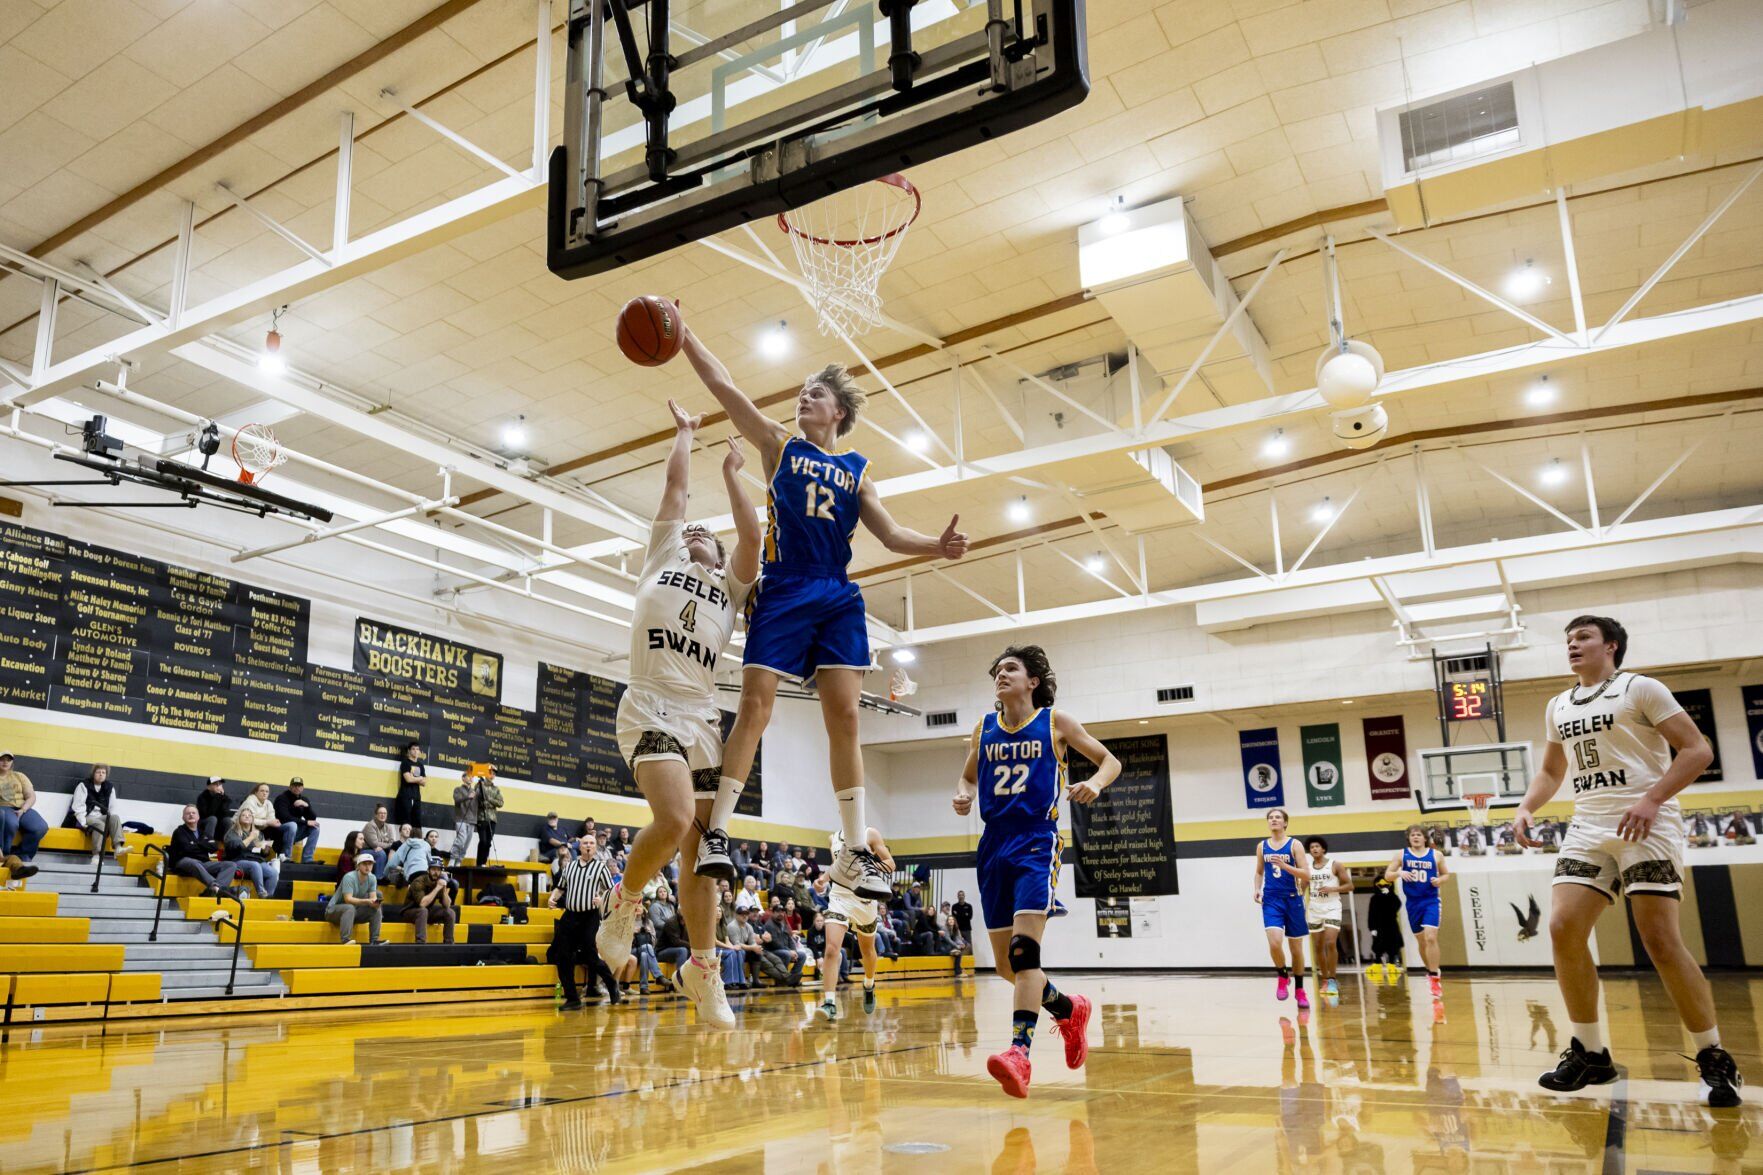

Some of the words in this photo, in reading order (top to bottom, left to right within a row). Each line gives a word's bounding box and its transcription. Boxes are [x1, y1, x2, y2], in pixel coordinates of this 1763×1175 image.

[791, 455, 855, 495] VICTOR
[806, 481, 836, 521] 12
[5, 528, 42, 543] Alliance
[6, 551, 32, 565] Cahoon
[34, 558, 50, 569] Golf
[68, 545, 81, 556] The
[83, 549, 103, 563] Doug
[8, 561, 17, 574] by
[27, 586, 59, 600] Haines
[71, 570, 109, 587] Stevenson
[138, 585, 150, 597] Inc
[657, 571, 728, 611] SEELEY
[70, 590, 89, 603] Mike
[112, 599, 146, 616] Memorial
[180, 601, 213, 616] Gordon
[8, 606, 34, 620] Liquor
[35, 613, 56, 625] Store
[77, 602, 94, 614] Golf
[95, 606, 137, 625] Tournament
[679, 599, 697, 633] 4
[71, 627, 137, 647] AUTOMOTIVE
[89, 621, 122, 634] GLEN'S
[175, 624, 192, 636] Class
[193, 628, 201, 637] of
[22, 637, 47, 651] Body
[72, 641, 95, 654] Lynda
[96, 646, 103, 655] &
[105, 648, 131, 661] Roland
[174, 642, 211, 657] ROVERO'S
[360, 623, 468, 668] BLACKHAWK
[648, 628, 716, 672] SWAN
[1, 657, 46, 674] Excavation
[68, 651, 100, 666] Matthew
[102, 657, 109, 666] &
[110, 659, 134, 673] Family
[235, 653, 246, 663] The
[285, 664, 304, 676] Family
[368, 649, 458, 688] BOOSTERS
[66, 664, 90, 676] Shawn
[92, 669, 99, 678] &
[101, 670, 127, 683] Sharon
[160, 662, 172, 673] The
[173, 665, 199, 678] Gleason
[201, 670, 222, 684] Family
[231, 677, 241, 686] Bill
[12, 687, 46, 701] Market
[94, 680, 101, 690] &
[103, 681, 126, 696] Family
[146, 684, 166, 695] Conor
[167, 688, 174, 697] &
[175, 689, 202, 701] Amanda
[1453, 683, 1485, 696] 5:14
[61, 695, 102, 709] Maughan
[104, 701, 133, 715] Family
[146, 702, 159, 714] Key
[161, 705, 169, 714] To
[170, 706, 182, 716] The
[183, 708, 204, 720] World
[205, 711, 225, 723] Travel
[244, 700, 265, 711] Nature
[266, 703, 288, 715] Scapes
[1454, 696, 1481, 717] 32
[151, 714, 158, 724] &
[198, 721, 219, 734] Family
[318, 713, 331, 722] Carl
[1558, 714, 1613, 741] SEELEY
[985, 740, 1041, 762] VICTOR
[1574, 738, 1600, 771] 15
[994, 764, 1029, 796] 22
[1573, 769, 1626, 794] SWAN
[1088, 828, 1105, 837] Down
[1120, 825, 1137, 835] other
[1138, 824, 1157, 834] colors
[1083, 842, 1100, 851] Black
[1101, 841, 1113, 850] and
[1114, 840, 1128, 852] gold
[1129, 839, 1148, 849] raised
[1149, 838, 1163, 851] high
[1082, 856, 1099, 865] Three
[1100, 855, 1119, 865] cheers
[1130, 852, 1167, 863] Blackhawks
[1406, 860, 1433, 870] VICTOR
[1103, 869, 1121, 881] Seeley
[1122, 870, 1139, 878] Swan
[1272, 864, 1281, 878] 3
[1109, 884, 1118, 893] Go
[1470, 886, 1486, 951] SEELEY
